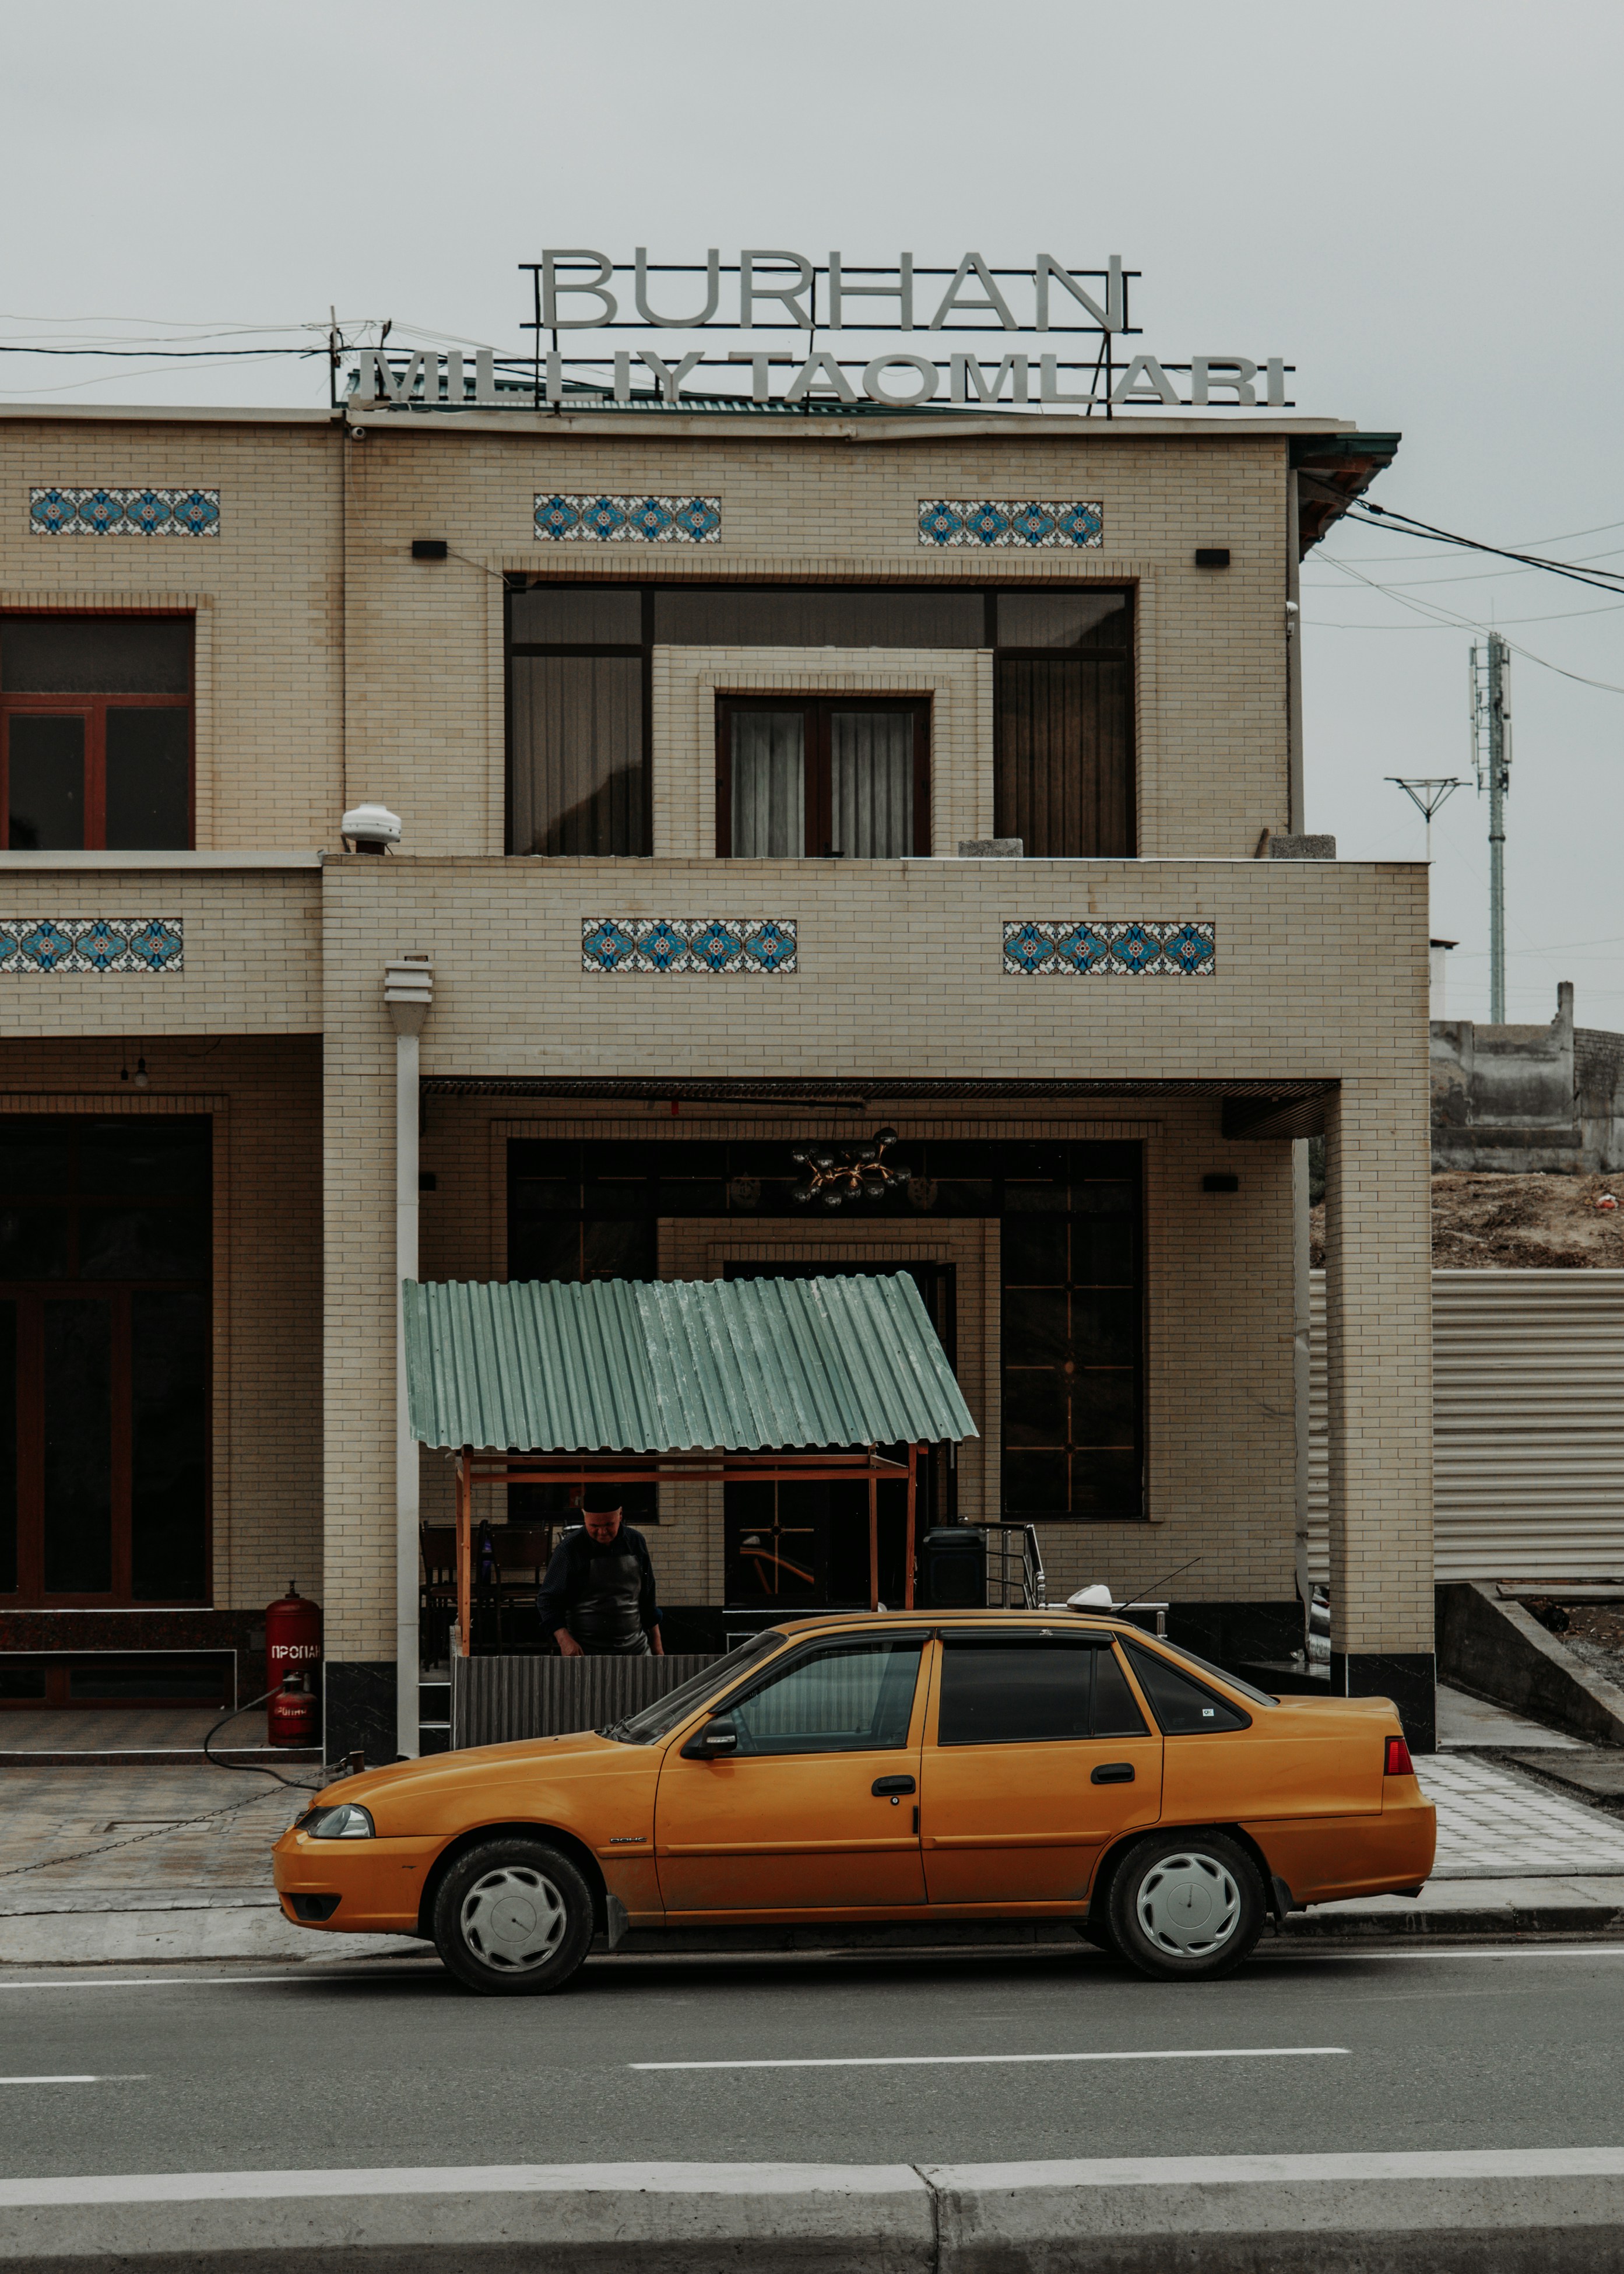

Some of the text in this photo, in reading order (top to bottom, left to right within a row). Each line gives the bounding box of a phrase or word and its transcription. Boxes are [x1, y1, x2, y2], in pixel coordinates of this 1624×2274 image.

[542, 247, 1122, 332] BURHAN
[360, 350, 1285, 408] MILLIY TAOMLARI
[272, 1645, 321, 1659] ПРОПАН
